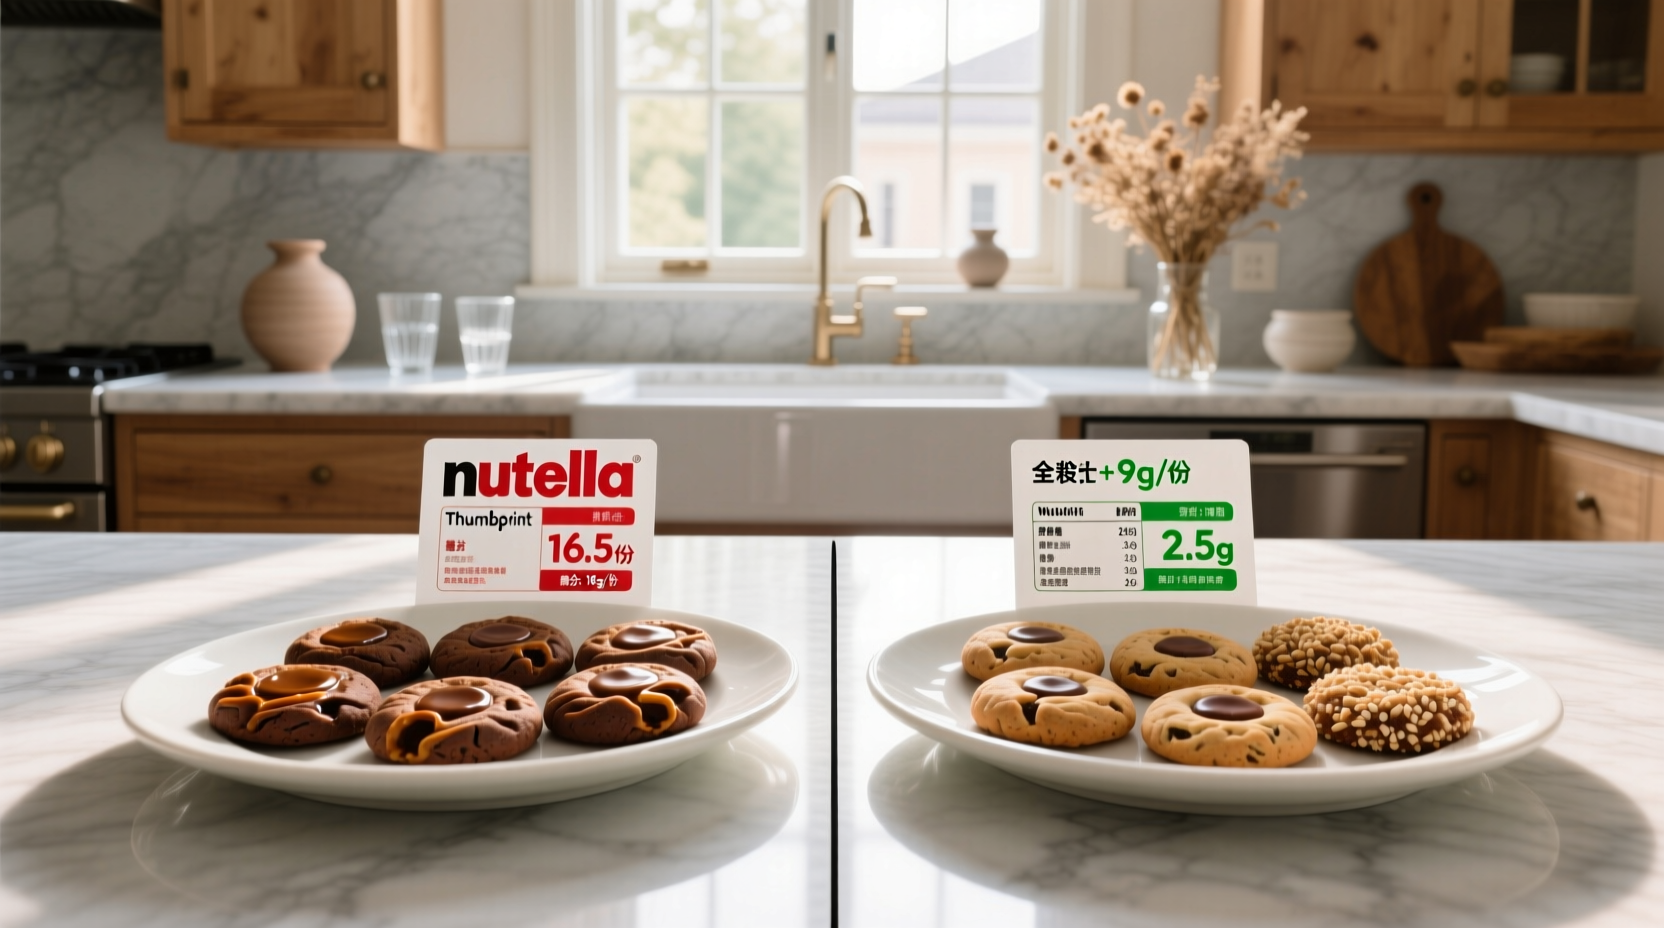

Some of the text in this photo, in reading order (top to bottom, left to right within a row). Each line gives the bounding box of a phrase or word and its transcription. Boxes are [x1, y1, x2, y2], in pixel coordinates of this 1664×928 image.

[443, 449, 634, 498] nutella
[445, 510, 533, 531] Thumbprint
[1162, 529, 1234, 566] 2.5g
